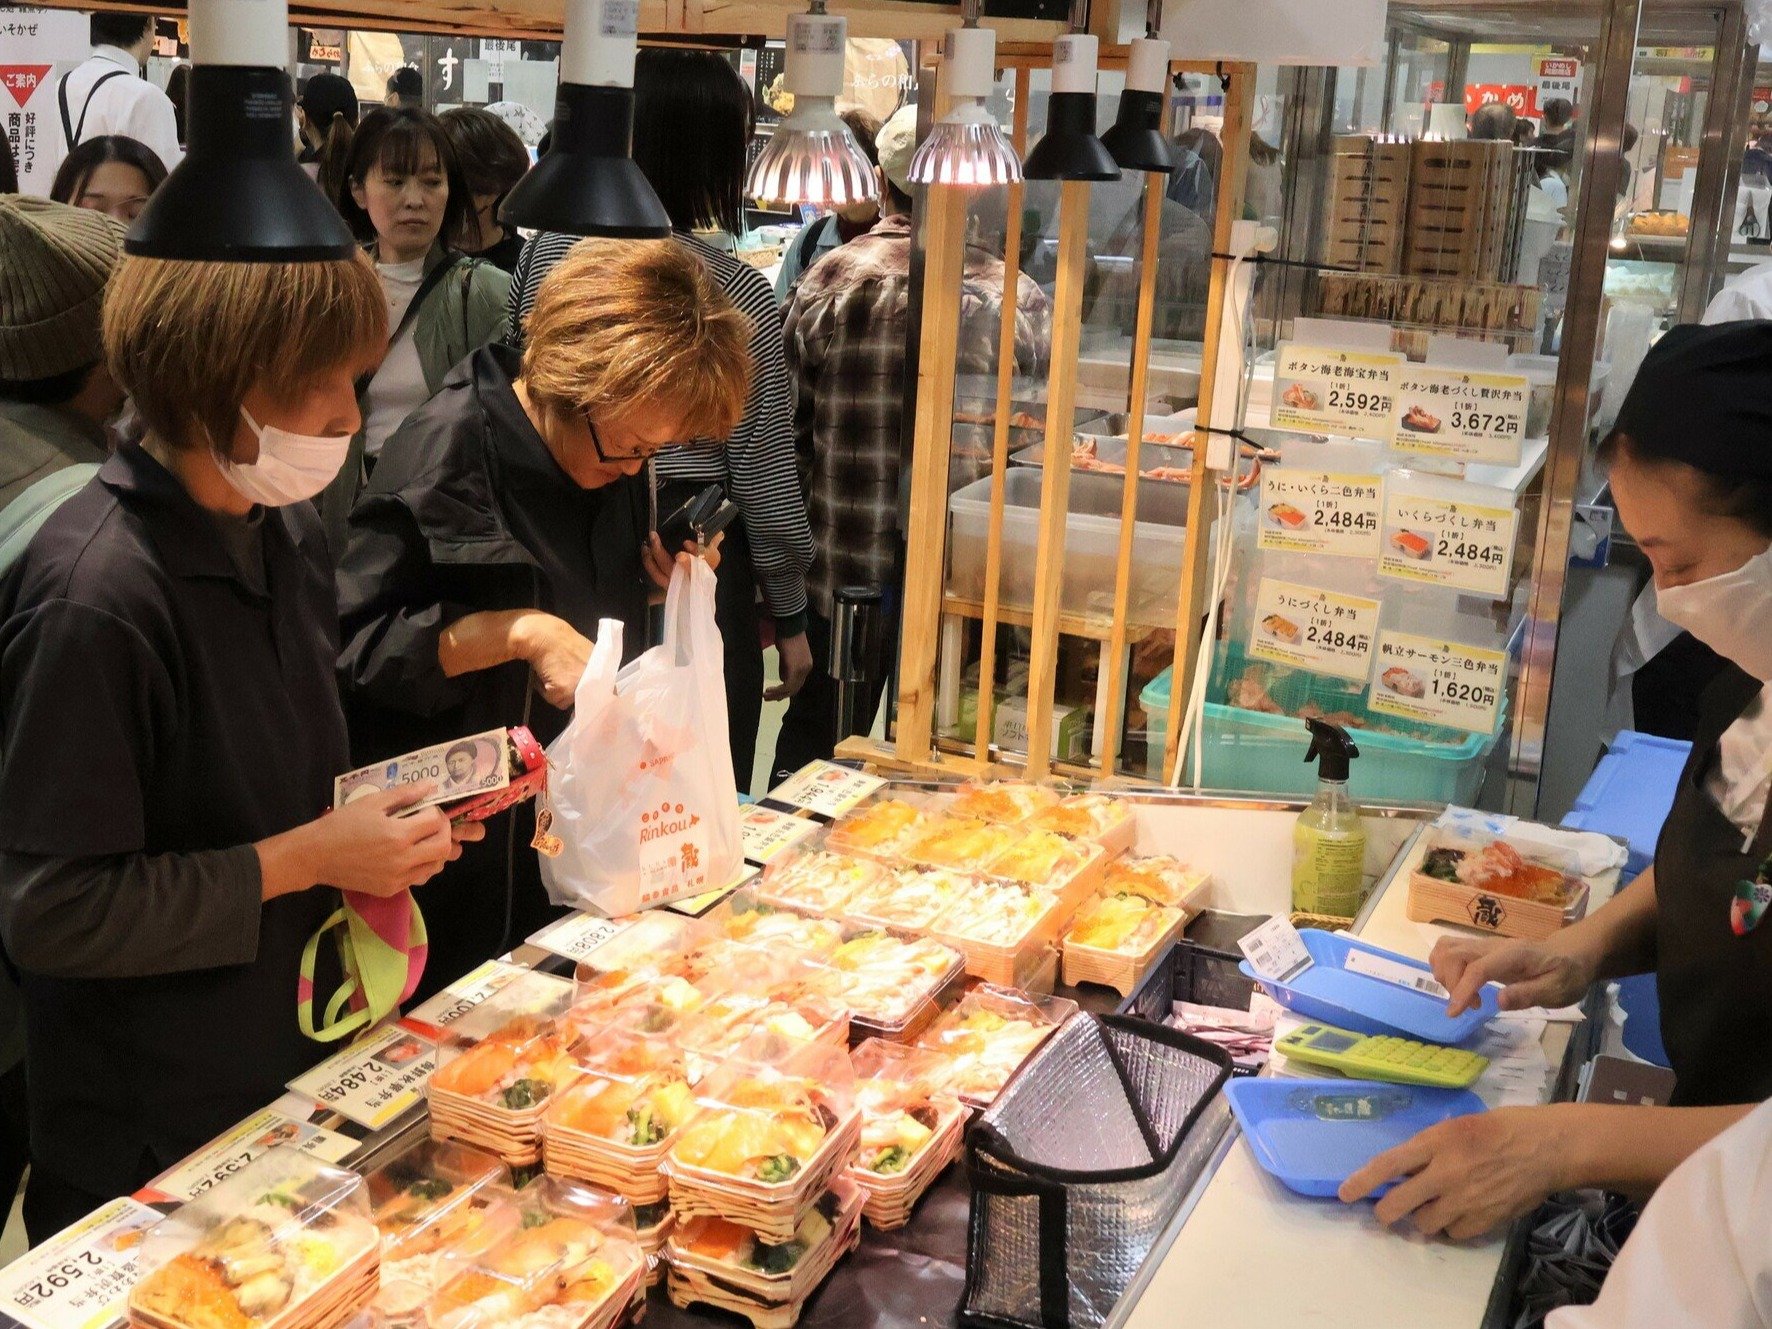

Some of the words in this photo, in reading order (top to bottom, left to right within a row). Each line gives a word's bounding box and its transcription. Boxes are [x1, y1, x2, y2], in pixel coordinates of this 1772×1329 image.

[6, 73, 37, 88] ご案内
[24, 112, 36, 173] 好評につき
[1288, 361, 1389, 381] ボタン海老海宝弁当
[1400, 381, 1522, 401] ボタン海老づくし贅沢弁当
[1268, 480, 1376, 499] うに・いくら二色弁当
[1398, 509, 1496, 532] いくらづくし弁当
[1278, 595, 1357, 620] うにづくし弁当
[1382, 643, 1498, 675] 帆立サーモン三色弁当
[401, 764, 439, 784] 5000
[481, 775, 503, 787] 5000
[639, 819, 687, 845] Rinkou
